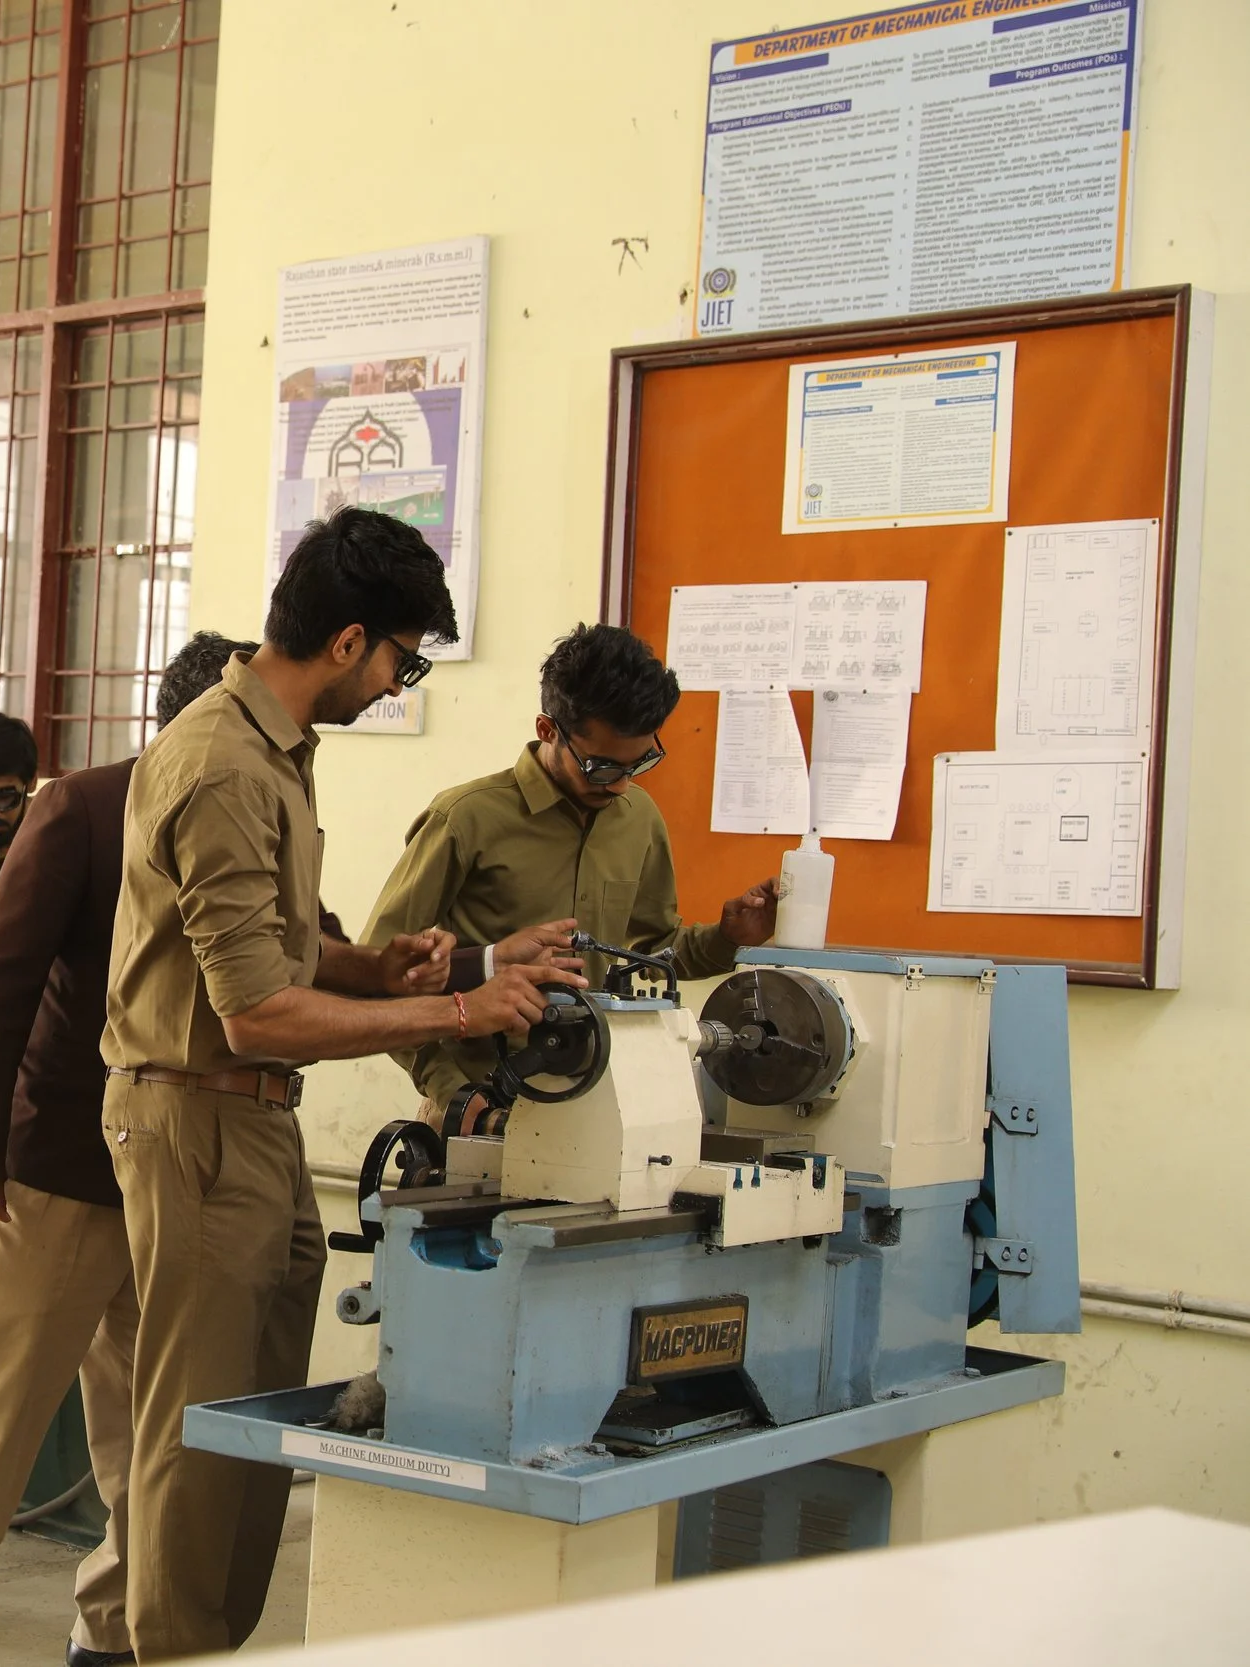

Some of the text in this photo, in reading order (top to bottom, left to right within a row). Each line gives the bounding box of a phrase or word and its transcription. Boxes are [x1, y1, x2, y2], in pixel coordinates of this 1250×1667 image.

[1088, 0, 1122, 13] Mission
[754, 28, 846, 58] DEPARTMENT
[850, 23, 869, 40] OF
[872, 2, 968, 36] MECHANICAL
[715, 73, 736, 82] Vision
[1015, 65, 1050, 81] Program
[1051, 57, 1092, 73] Outcomes
[711, 119, 741, 133] Program
[741, 111, 782, 126] Educational
[783, 105, 820, 121] Objectives
[286, 267, 326, 283] Rajasthan
[328, 264, 347, 276] state
[385, 254, 422, 270] minerals
[702, 299, 734, 327] JIET
[826, 359, 976, 382] DEPARTMENT OF MECHANICAL ENGINEERING
[805, 500, 822, 514] JIET
[642, 1318, 742, 1362] MACPOWER
[319, 1442, 450, 1477] MACHINE (MEDIUM DUTY)
